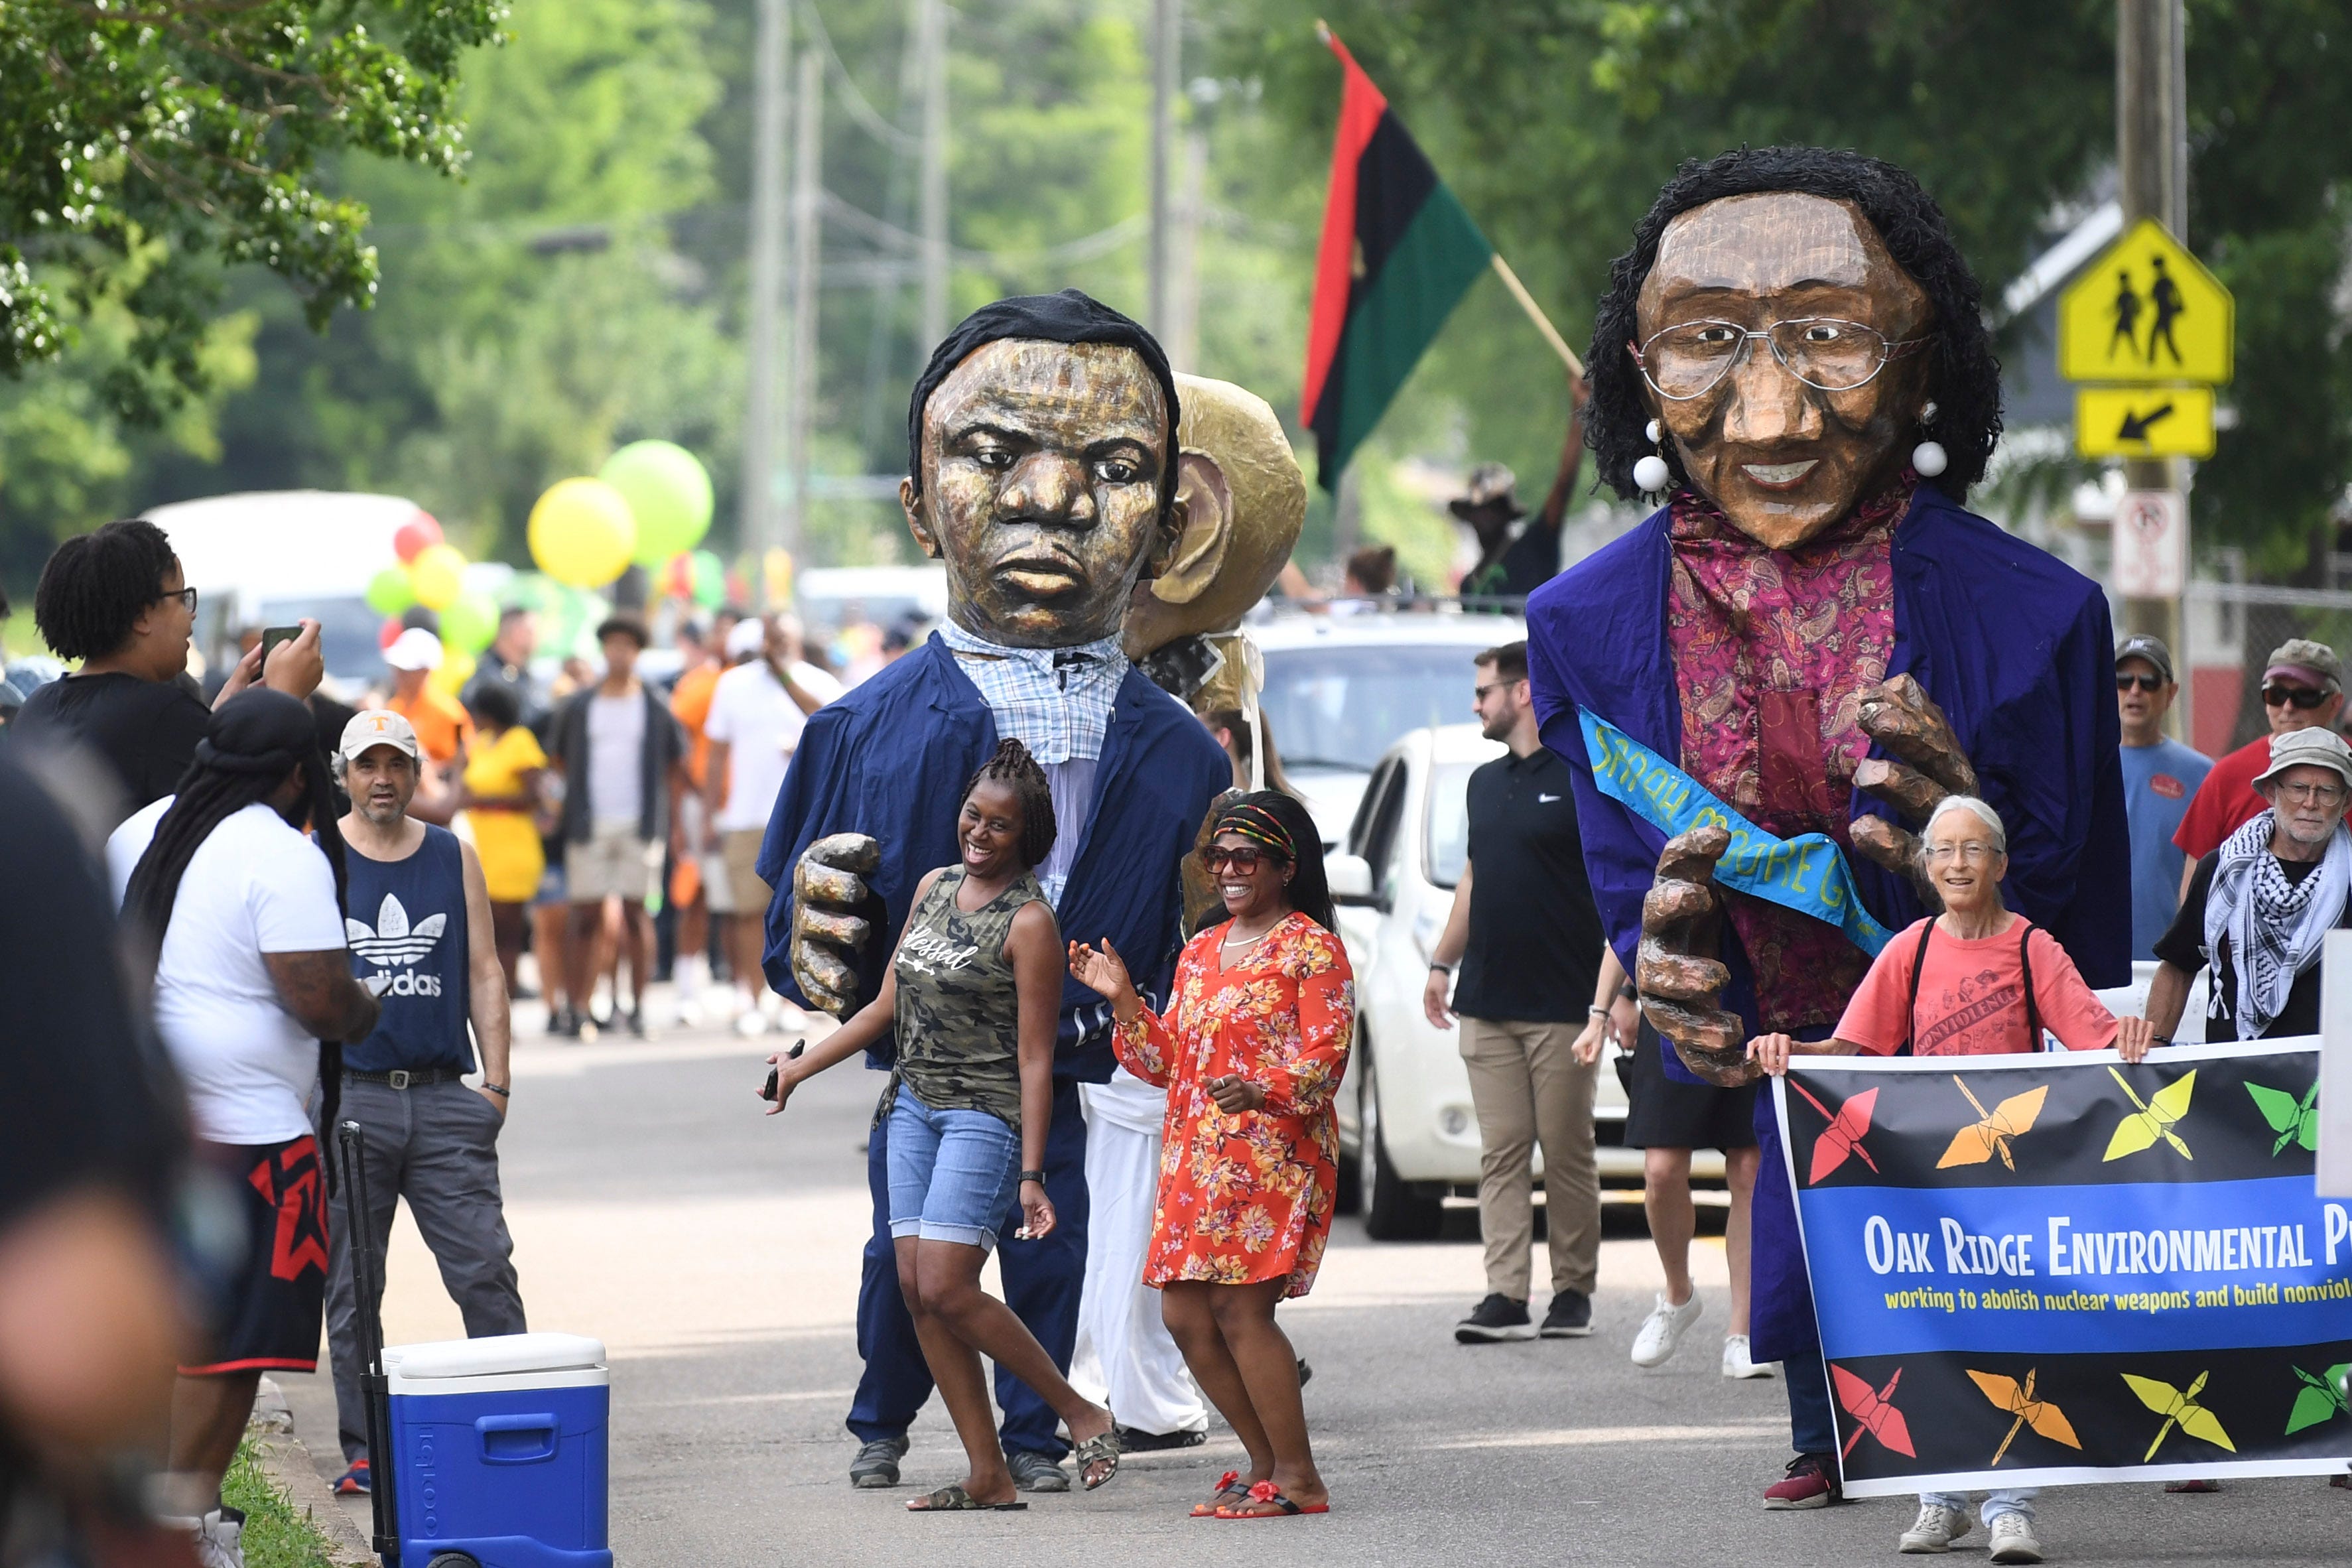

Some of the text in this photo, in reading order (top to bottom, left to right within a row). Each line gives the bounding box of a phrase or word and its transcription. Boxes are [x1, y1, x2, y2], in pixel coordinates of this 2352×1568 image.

[369, 716, 389, 732] T
[355, 968, 442, 998] idas
[1884, 1285, 1955, 1313] working
[1958, 1287, 1977, 1309] to
[1981, 1288, 2040, 1311] abolish
[2044, 1289, 2110, 1311] nuclear
[2114, 1289, 2191, 1315] weapons
[2195, 1284, 2229, 1307] and
[2233, 1281, 2278, 1307] build
